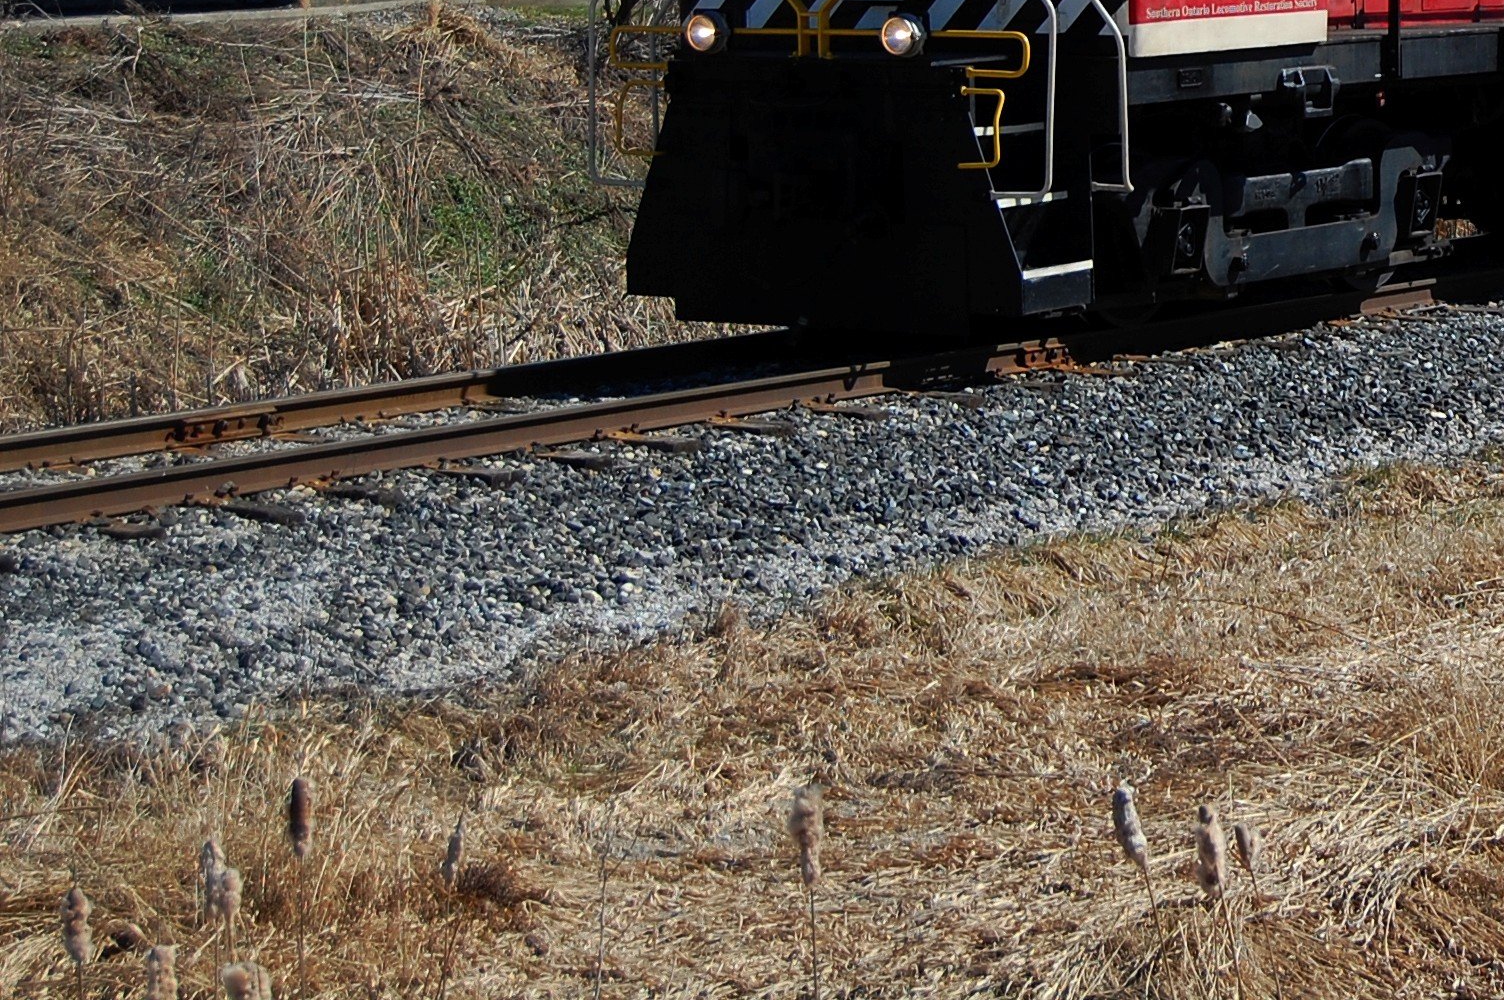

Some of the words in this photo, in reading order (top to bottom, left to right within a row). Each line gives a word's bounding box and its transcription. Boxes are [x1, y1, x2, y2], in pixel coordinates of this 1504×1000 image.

[1146, 7, 1181, 18] Southern
[1182, 5, 1210, 16] Ontario
[1211, 2, 1253, 15] Locomotive
[1254, 0, 1294, 12] Restoration
